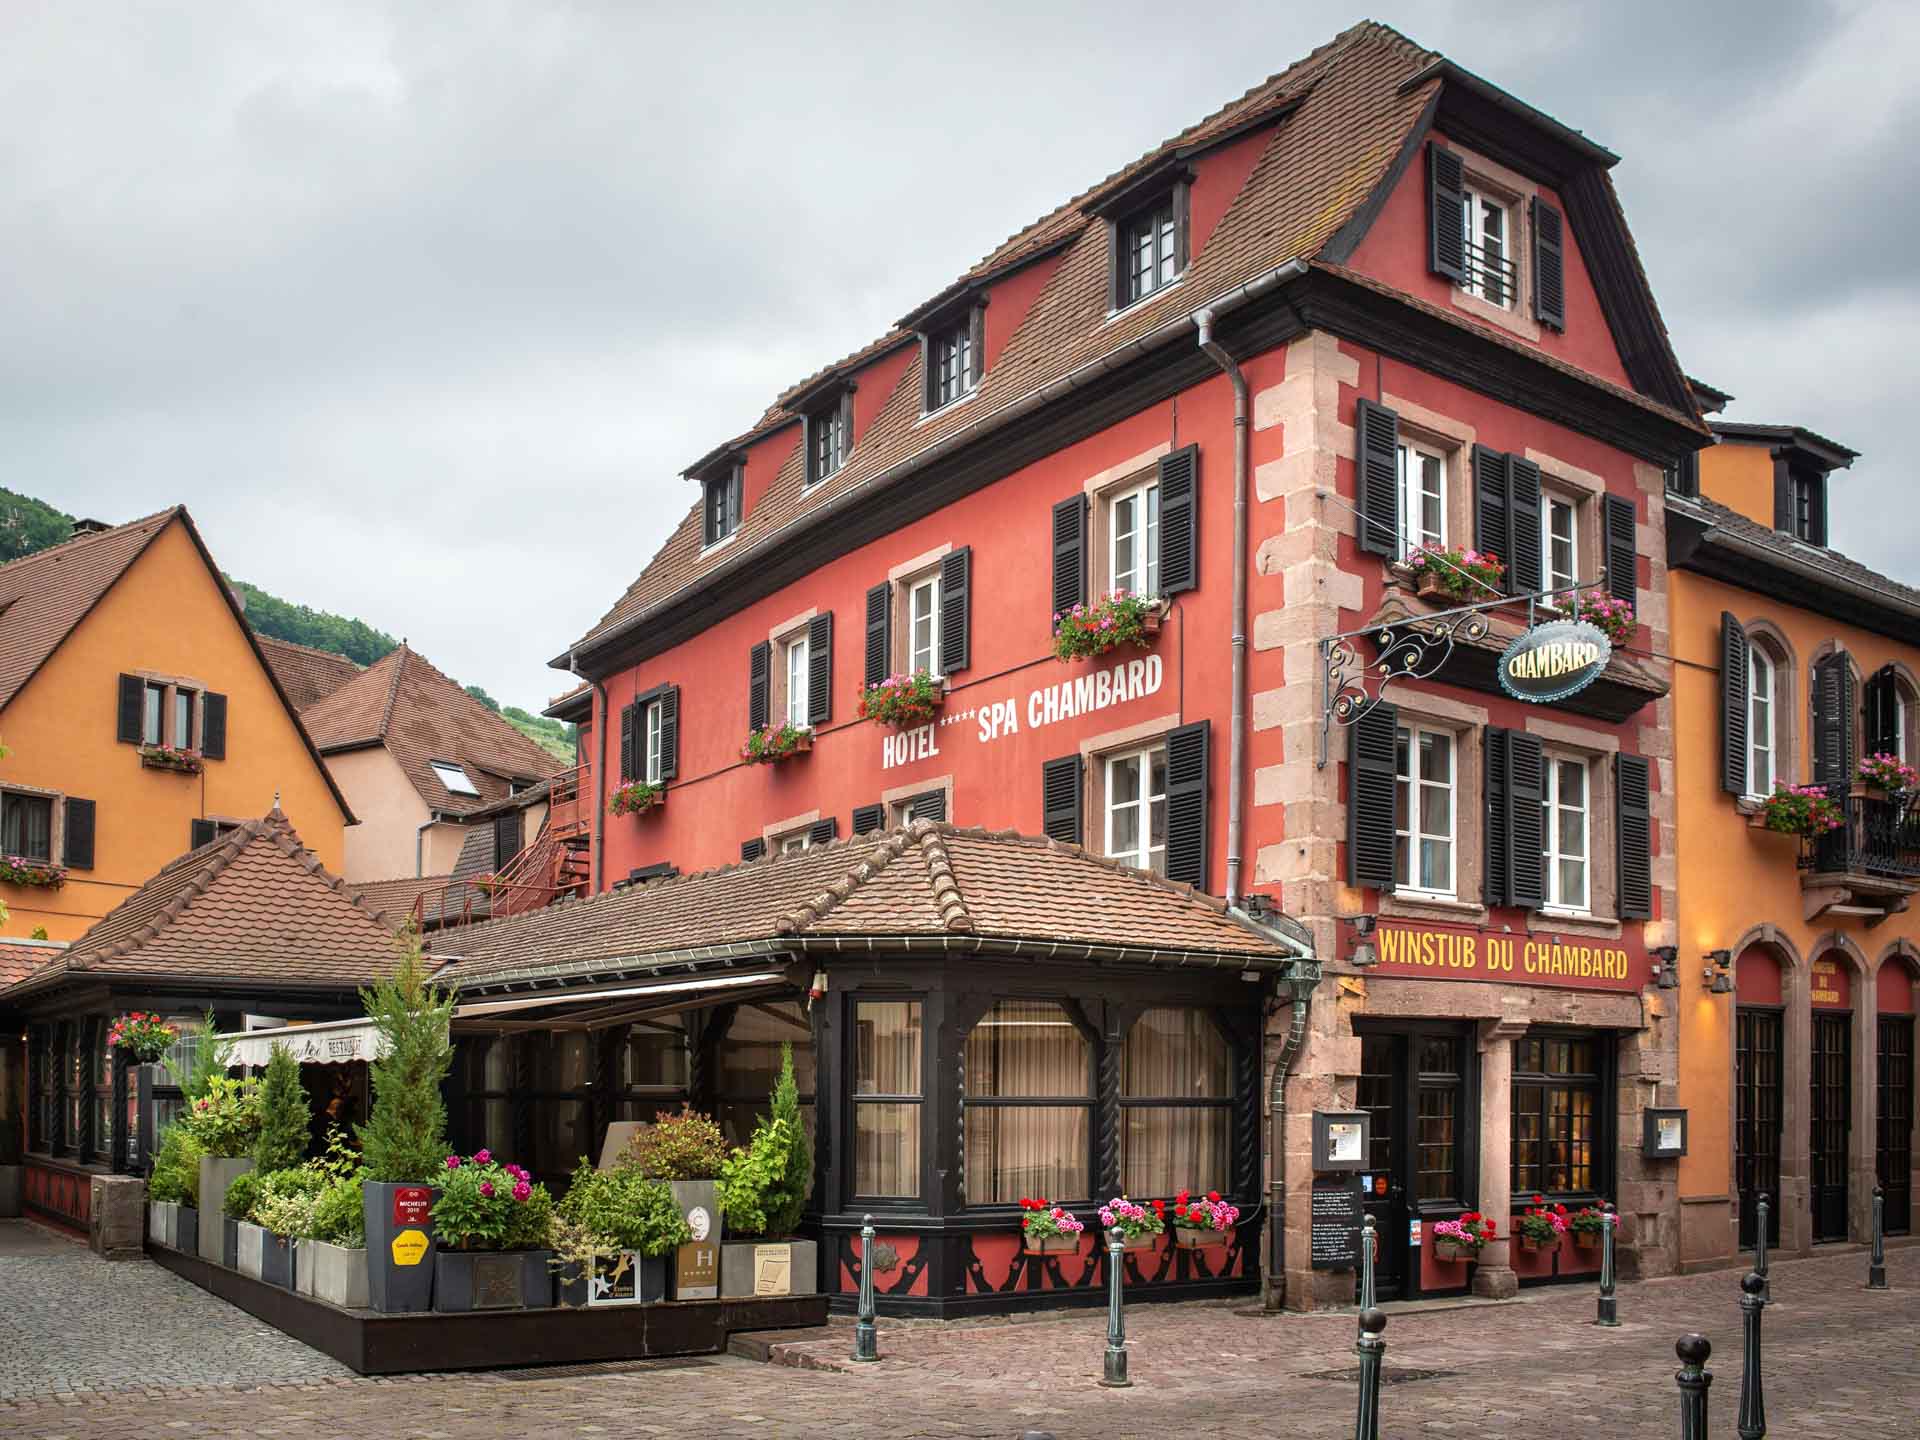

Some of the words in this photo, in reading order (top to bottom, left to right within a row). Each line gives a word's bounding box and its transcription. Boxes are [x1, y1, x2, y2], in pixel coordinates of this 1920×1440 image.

[1508, 642, 1601, 679] CHAMBARD
[882, 723, 940, 769] HOTEL
[977, 698, 1019, 743] SPA
[1027, 654, 1164, 728] CHAMBARD
[1378, 928, 1476, 969] WINSTUB
[1487, 938, 1514, 972] DU
[1523, 941, 1629, 980] CHAMBARD
[697, 1250, 713, 1266] H
